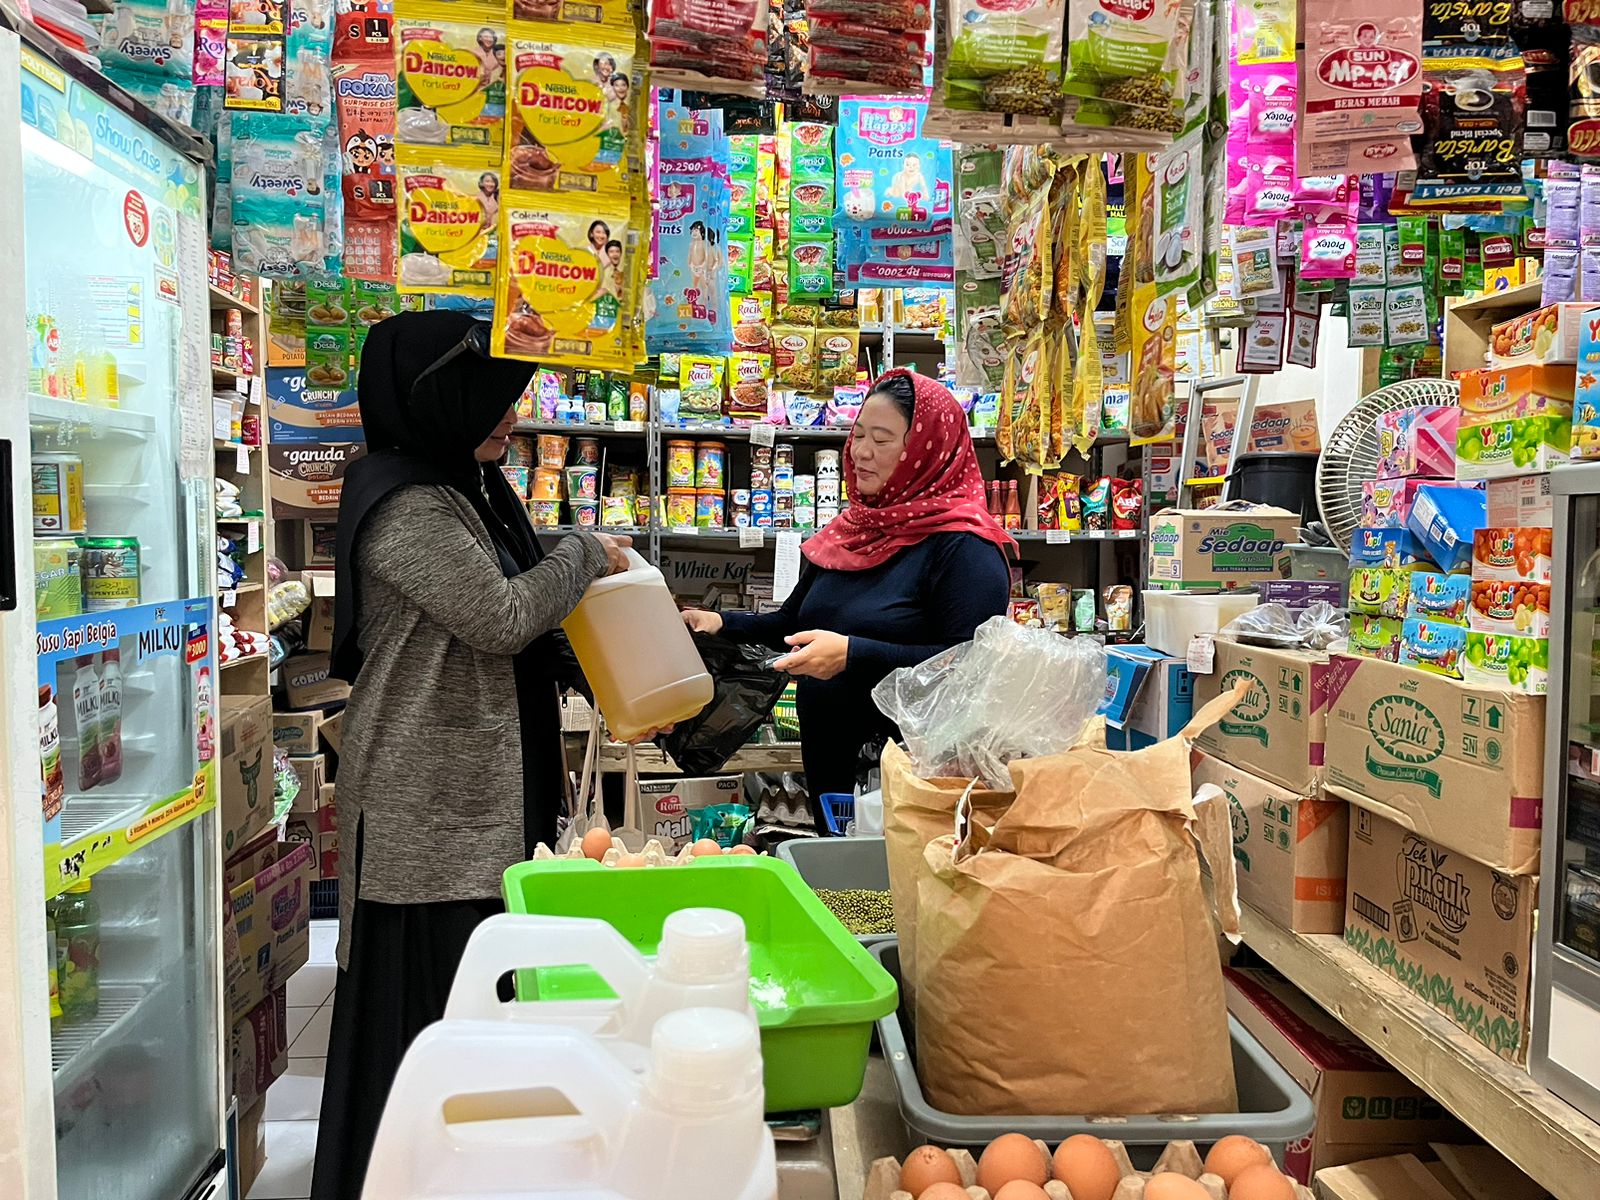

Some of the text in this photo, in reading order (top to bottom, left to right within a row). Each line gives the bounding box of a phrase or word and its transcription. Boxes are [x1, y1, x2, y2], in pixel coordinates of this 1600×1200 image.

[1430, 1, 1511, 25] Barista
[349, 26, 359, 37] S
[373, 20, 379, 31] 1
[1461, 23, 1481, 33] TOP
[120, 41, 171, 59] Sweety
[1353, 51, 1385, 62] SUN
[1433, 48, 1478, 57] EXTRA
[406, 52, 478, 79] Dancow
[545, 83, 578, 94] Nestlé
[521, 82, 602, 114] Dancow
[1334, 97, 1400, 108] BERAS MERAH
[1264, 112, 1294, 122] Protex
[679, 121, 693, 134] XL
[862, 118, 913, 134] Happy!
[1451, 129, 1503, 138] Special Blend
[96, 112, 161, 174] Show Case
[869, 147, 903, 158] Pants
[1434, 139, 1514, 162] Barista
[1465, 161, 1488, 170] TOP
[251, 175, 303, 189] Sweety
[377, 182, 383, 192] 1
[354, 187, 364, 198] S
[1435, 186, 1481, 195] EXTRA
[1501, 185, 1522, 194] Beli
[1263, 191, 1290, 202] Protex
[411, 201, 480, 224] Dancow
[900, 213, 909, 221] M
[659, 223, 682, 234] ants
[1316, 239, 1345, 250] Protex
[541, 252, 572, 262] Nestlé
[518, 251, 596, 280] Dancow
[872, 267, 920, 277] Rp.2000,-
[314, 281, 342, 290] Desaku
[363, 282, 391, 290] Desaku
[737, 304, 762, 315] Racik
[1511, 318, 1532, 341] Yupi
[314, 340, 341, 351] Desaku
[282, 353, 305, 361] POTATO
[688, 369, 713, 381] Racik
[738, 364, 762, 376] Racik
[1480, 374, 1506, 396] Yupi
[301, 389, 341, 402] CRUNCHY
[1480, 424, 1513, 447] Yupi
[290, 447, 346, 467] garuda
[1479, 449, 1511, 460] Bolicious
[299, 462, 336, 476] CRUNCHY
[1116, 495, 1142, 508] ABC
[1150, 531, 1180, 544] Sedaap
[1209, 528, 1229, 537] Mie
[1363, 530, 1382, 548] Yupi
[1198, 535, 1286, 556] Sedaap
[1489, 530, 1515, 553] Yupi
[1488, 556, 1515, 564] Bolicious
[674, 560, 720, 579] White
[1172, 562, 1178, 575] 9
[1362, 571, 1381, 588] Yupi
[1426, 575, 1446, 595] Yupi
[1489, 584, 1515, 606] Yupi
[1488, 608, 1514, 617] Bolicious
[1363, 616, 1381, 635] Yupi
[37, 620, 117, 655] Susu Sapi Belgia
[1418, 623, 1440, 644] Yupi
[138, 624, 181, 660] MILKU
[1485, 633, 1511, 655] Yupi
[192, 640, 207, 658] 3000
[1280, 668, 1287, 682] 7
[1467, 698, 1476, 715] 7
[1381, 706, 1429, 746] Sania
[1463, 736, 1478, 754] SNI
[718, 781, 737, 789] PACK
[1267, 796, 1274, 810] 7
[1402, 835, 1428, 863] Teh
